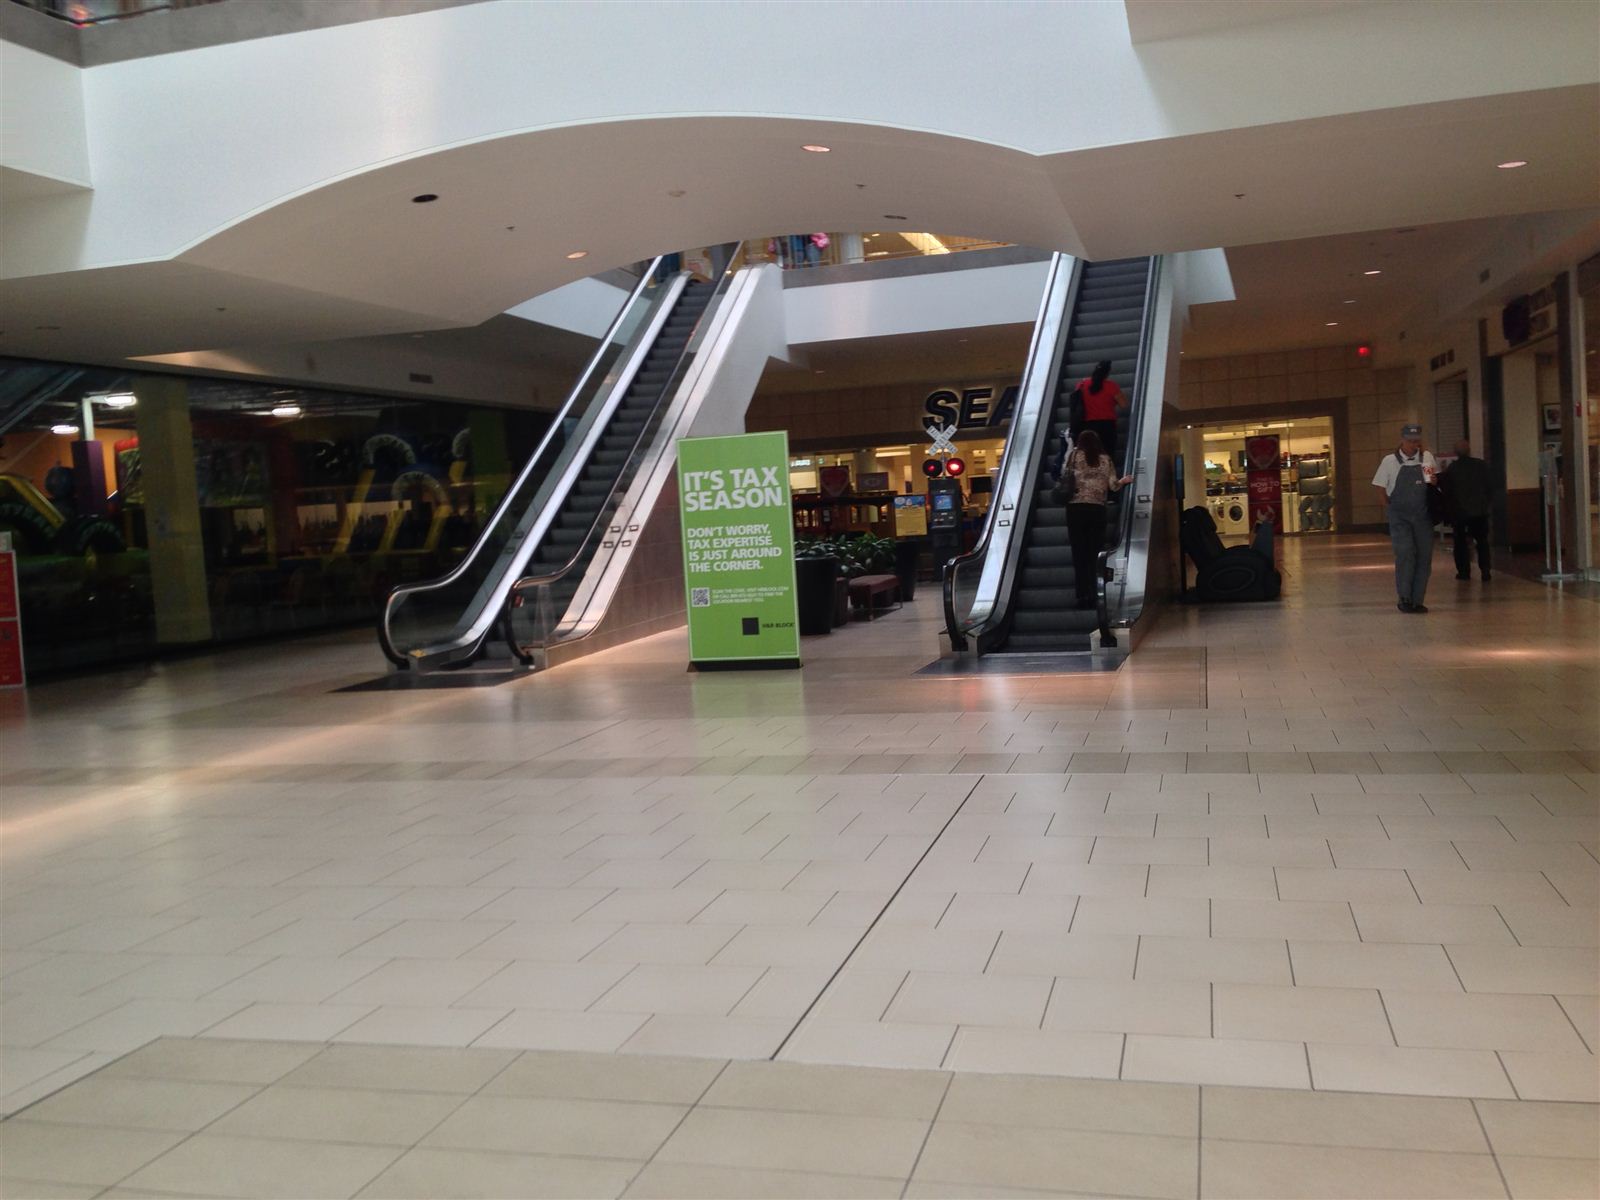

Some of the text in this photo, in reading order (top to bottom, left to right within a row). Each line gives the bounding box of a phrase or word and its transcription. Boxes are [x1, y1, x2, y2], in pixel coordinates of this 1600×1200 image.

[684, 466, 779, 491] IT'S TAX
[684, 487, 786, 512] SEASON.
[687, 524, 771, 538] DON'T WORRY,
[687, 536, 773, 550] TAX EXPERTISE
[689, 547, 782, 561] IS JUST AROUND
[689, 560, 764, 572] THE CORNER.
